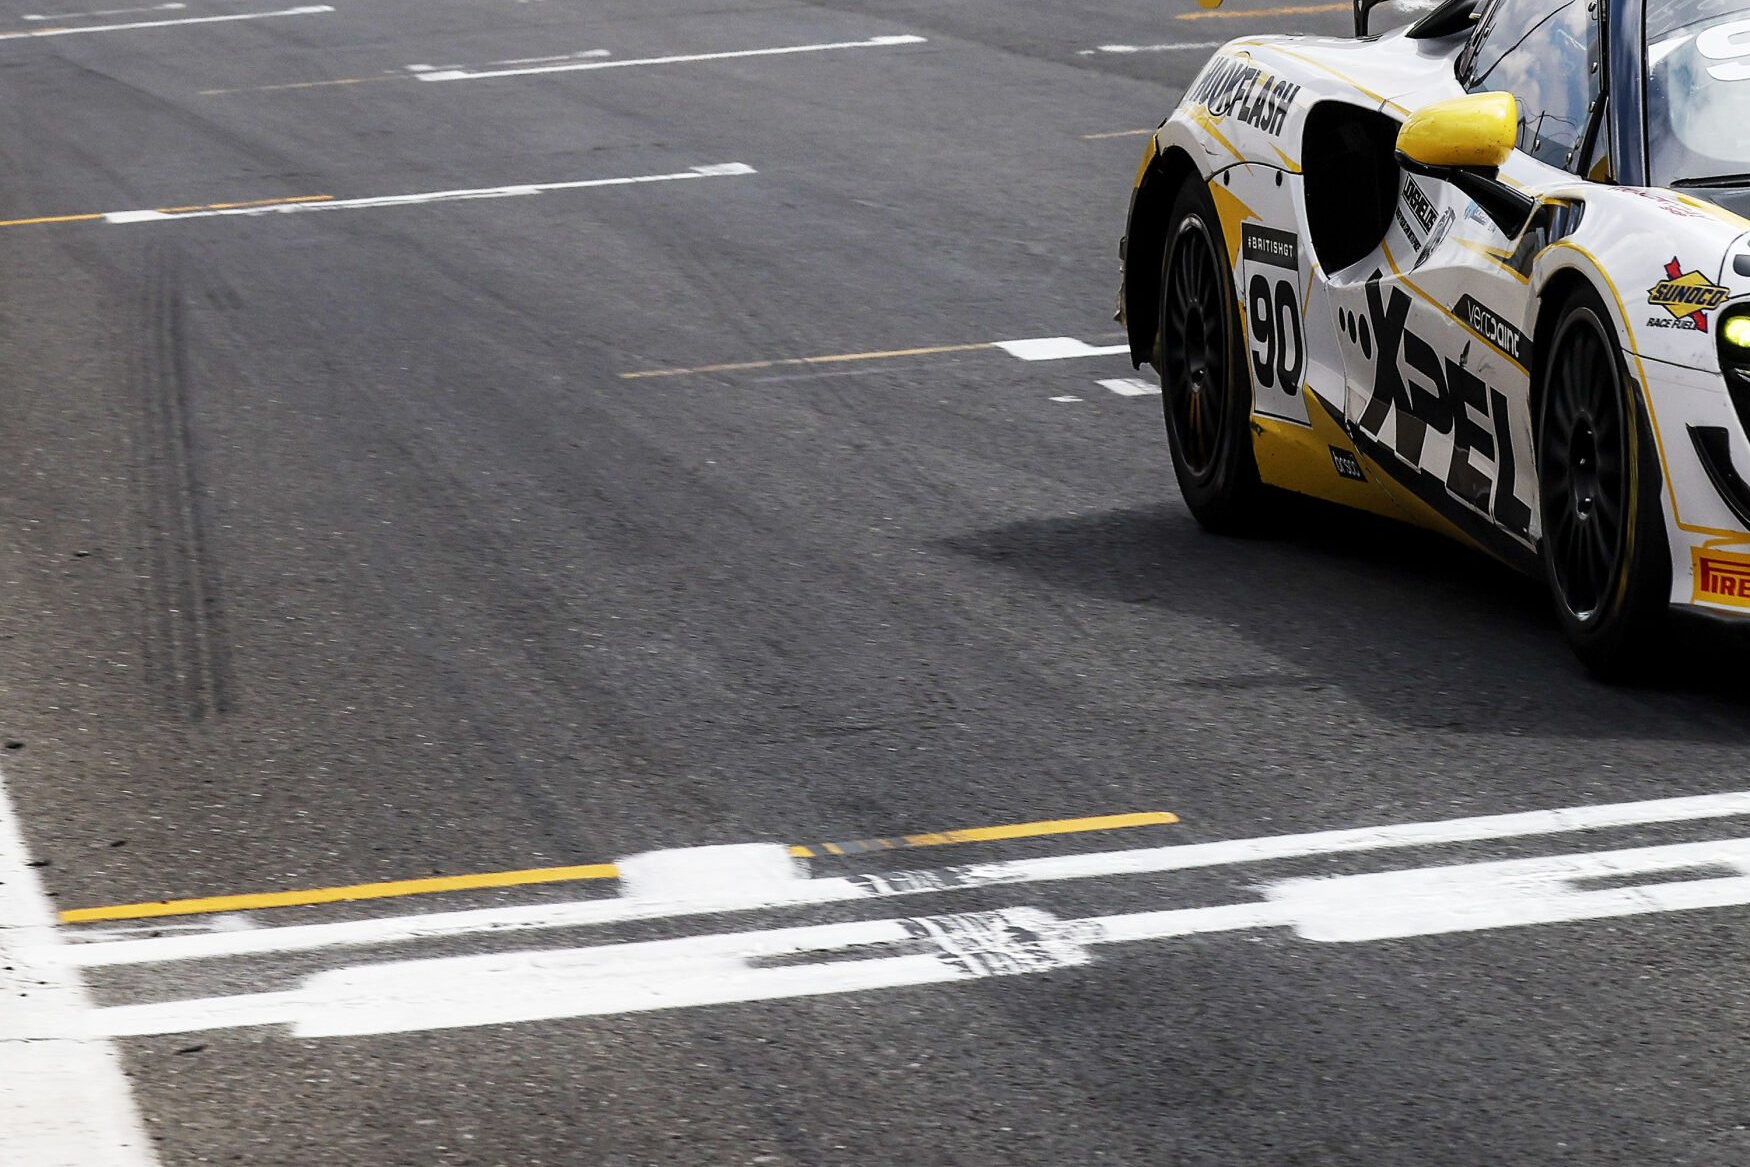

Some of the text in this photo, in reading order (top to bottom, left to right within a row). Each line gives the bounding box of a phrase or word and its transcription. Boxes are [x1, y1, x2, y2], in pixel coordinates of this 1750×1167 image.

[1247, 236, 1294, 258] #BRITISHGT
[1651, 284, 1727, 306] SUNOCO
[1646, 318, 1672, 329] RACE
[1249, 274, 1303, 396] 90
[1359, 268, 1534, 546] XPEL
